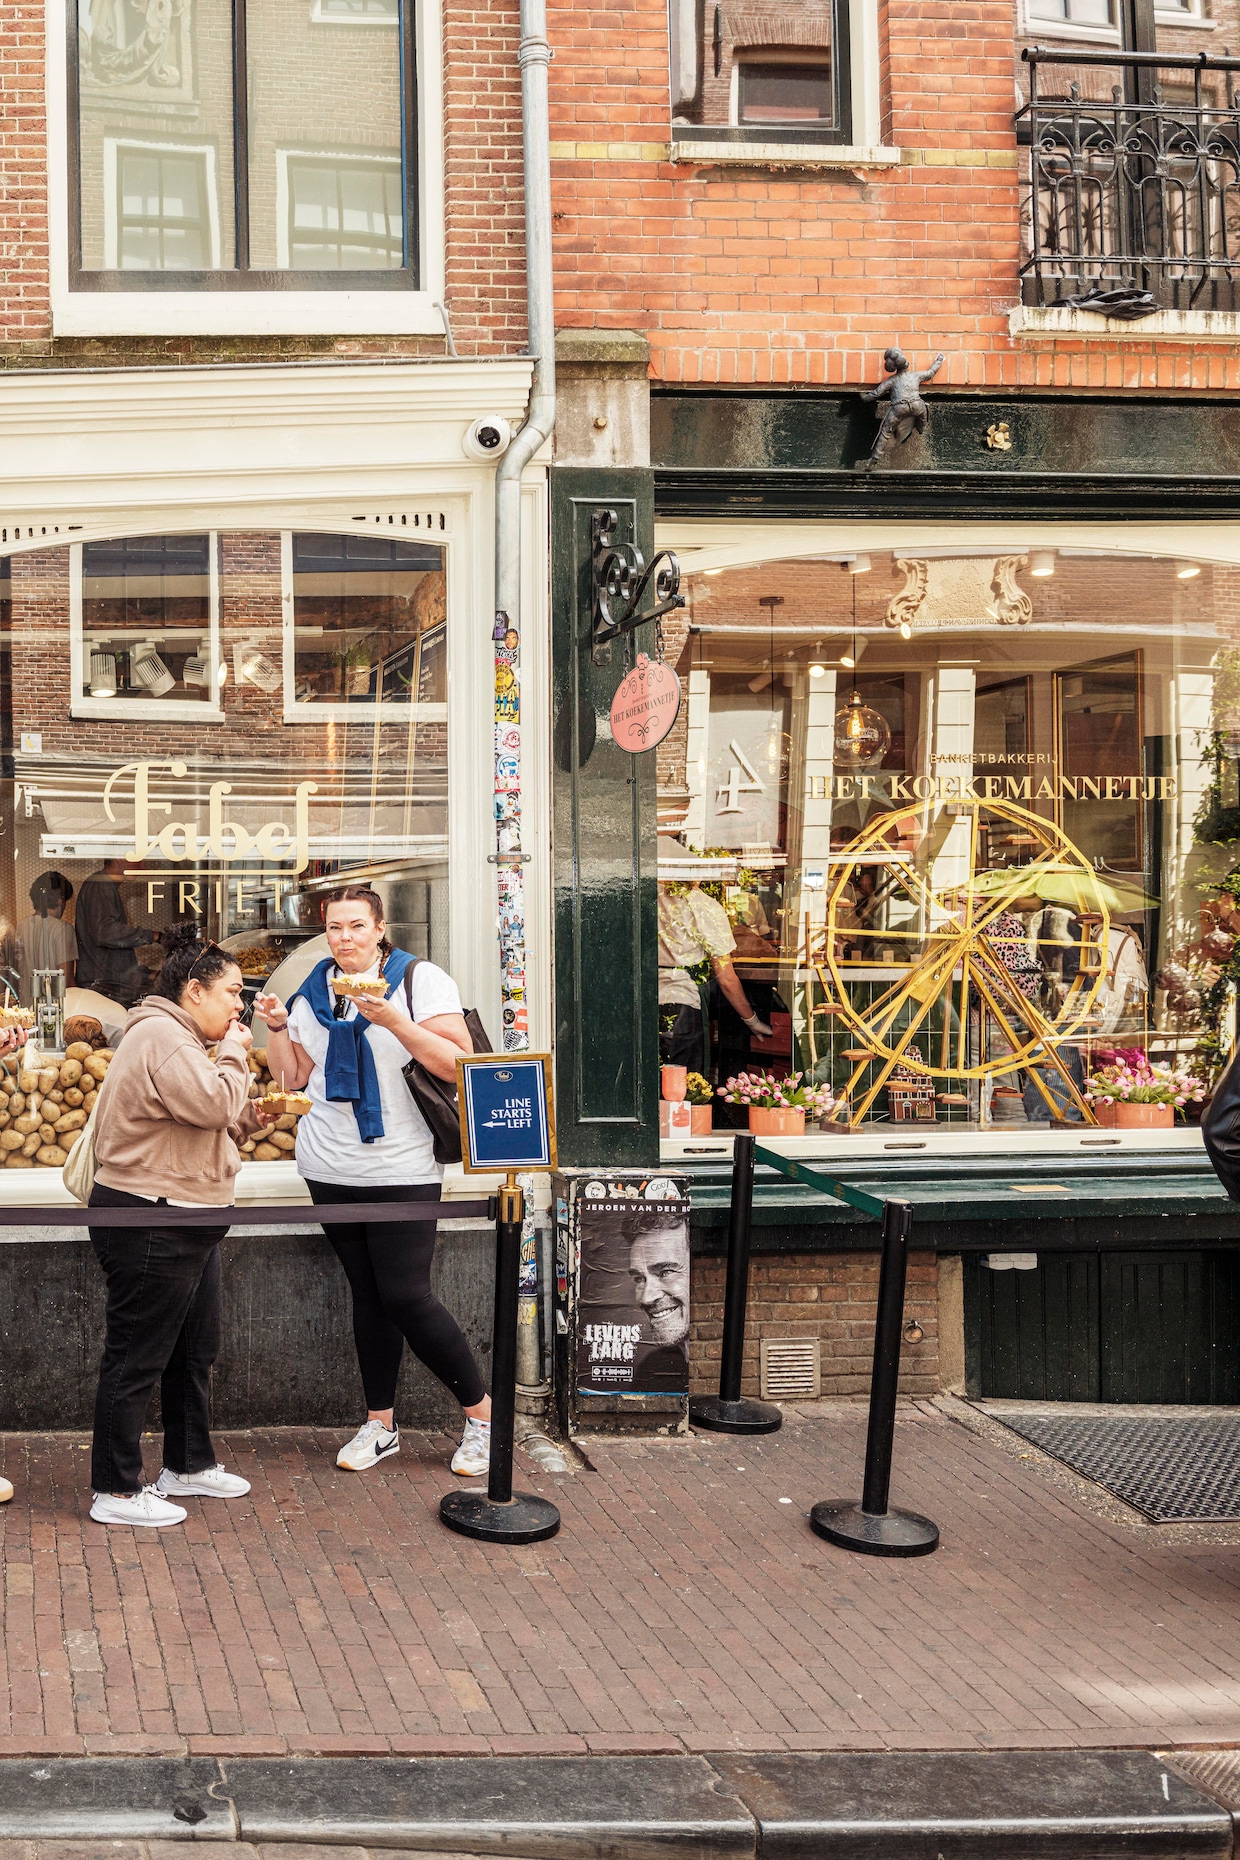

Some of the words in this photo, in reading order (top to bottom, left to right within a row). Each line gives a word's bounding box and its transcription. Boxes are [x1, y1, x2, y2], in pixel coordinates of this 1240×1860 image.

[613, 711, 625, 724] HET
[625, 690, 675, 720] KOEKEMANNETJE
[929, 752, 1060, 765] BANKETBAKKERIJ
[808, 774, 875, 800] HET
[888, 774, 1180, 801] KOEKEMANNETJE
[103, 761, 319, 876] Fabel
[146, 880, 289, 914] FRIET
[505, 1097, 531, 1109] LINE
[491, 1108, 532, 1119] STARTS
[507, 1118, 532, 1129] LEFT
[631, 1204, 652, 1212] VAN
[585, 1324, 641, 1343] LEVENS
[590, 1341, 635, 1361] LANG
